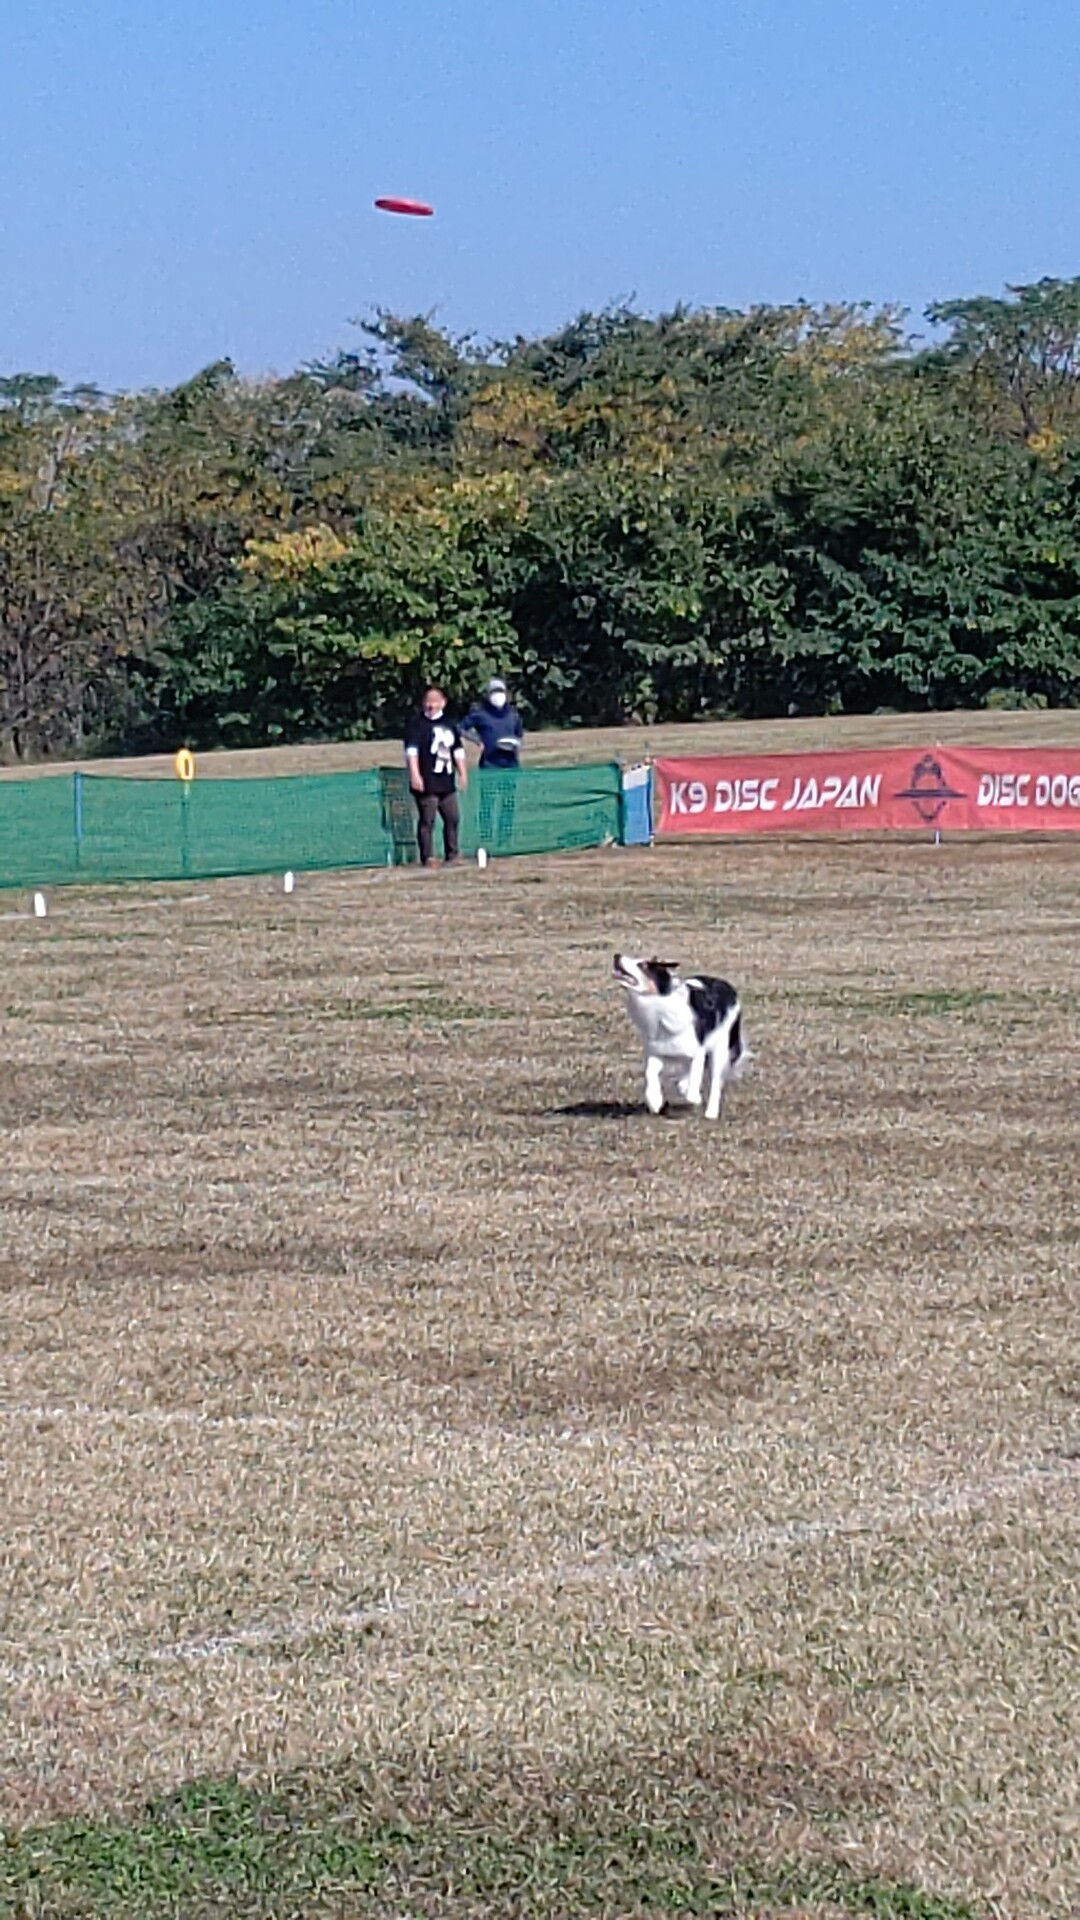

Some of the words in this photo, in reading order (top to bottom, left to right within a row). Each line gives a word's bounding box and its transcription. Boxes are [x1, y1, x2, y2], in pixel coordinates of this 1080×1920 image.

[669, 781, 708, 815] K9
[713, 778, 779, 813] DISC
[782, 773, 882, 811] JAPAN
[977, 774, 1031, 806] DISC
[1035, 775, 1080, 807] DOG
